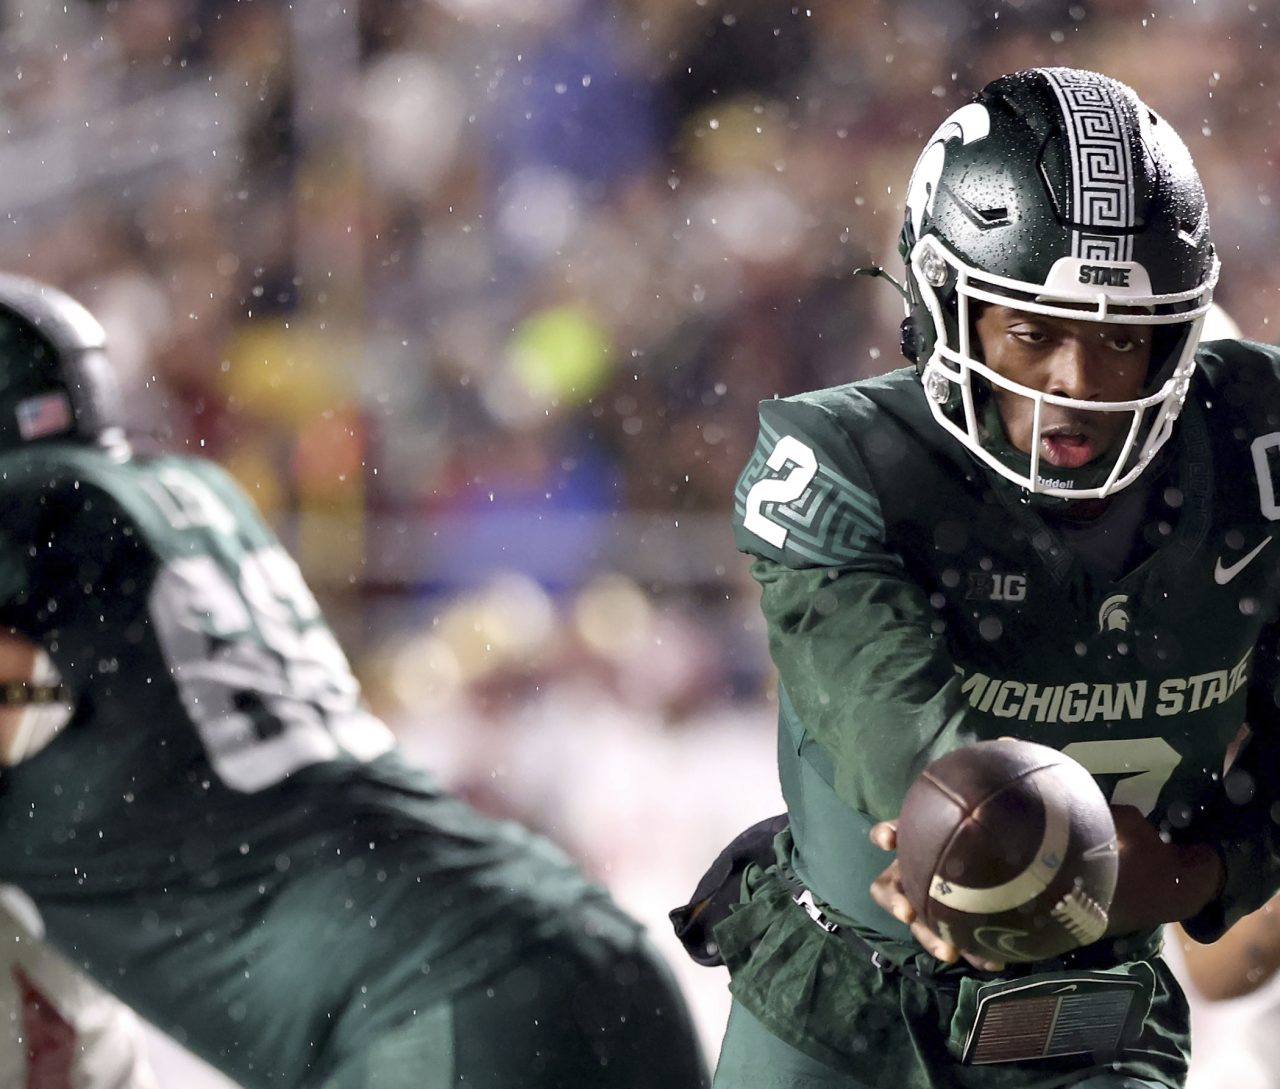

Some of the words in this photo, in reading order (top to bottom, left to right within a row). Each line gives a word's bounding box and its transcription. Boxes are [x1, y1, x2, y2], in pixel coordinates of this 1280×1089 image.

[1078, 264, 1132, 288] STATE
[743, 435, 818, 549] 2
[952, 663, 1148, 723] MICHIGAN
